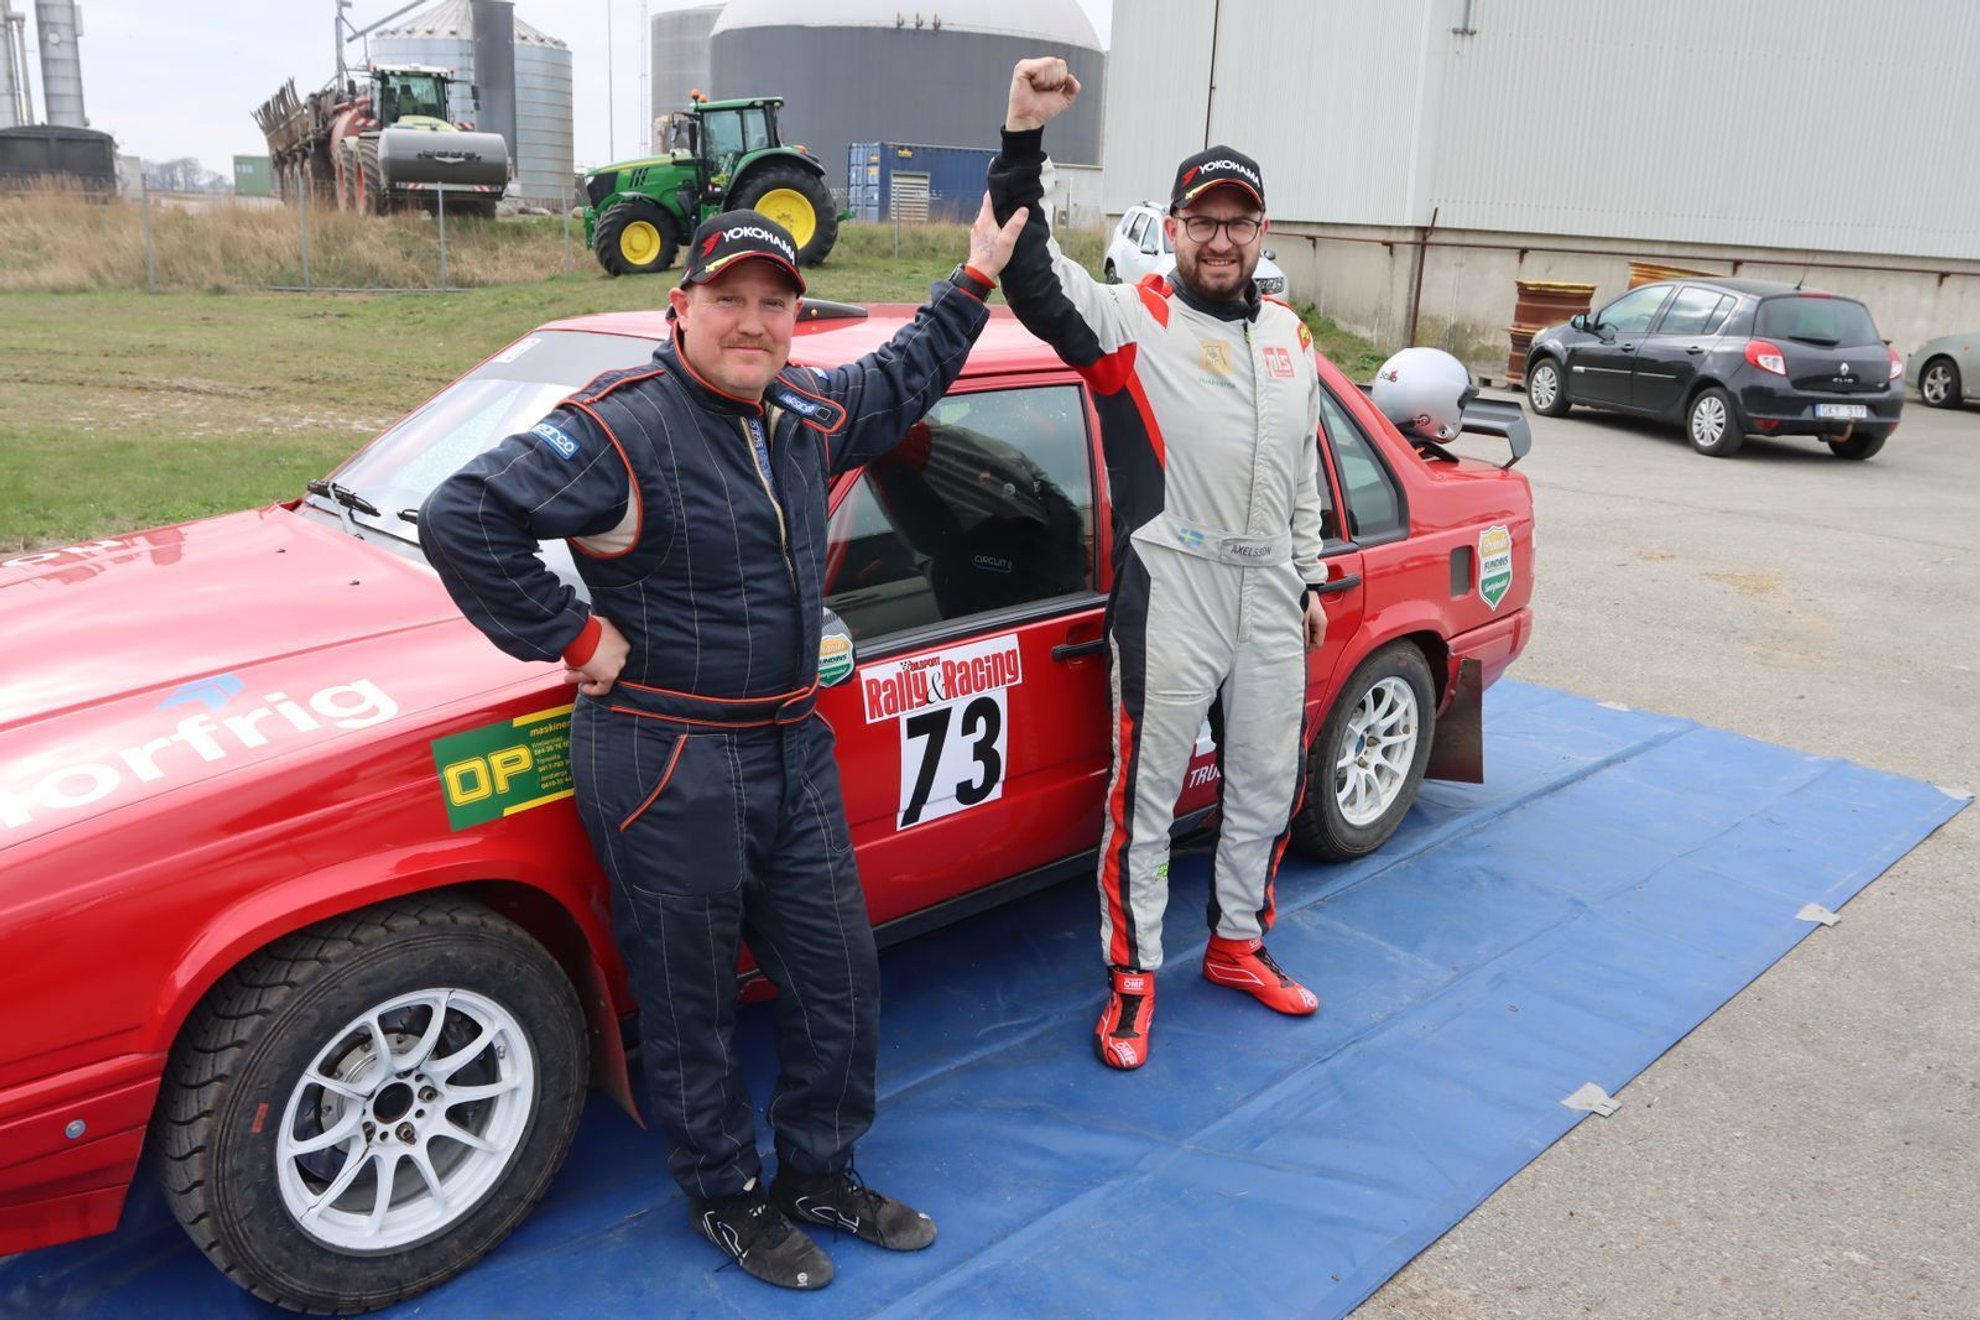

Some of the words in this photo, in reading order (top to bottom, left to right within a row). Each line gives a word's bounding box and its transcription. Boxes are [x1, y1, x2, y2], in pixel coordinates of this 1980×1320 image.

[1230, 543, 1273, 557] AXELSSON
[866, 668, 929, 720] Rally
[942, 648, 1020, 701] Racing
[443, 744, 534, 807] OP
[900, 696, 1002, 828] 73
[1188, 764, 1221, 789] TRU
[1123, 978, 1145, 988] OMP
